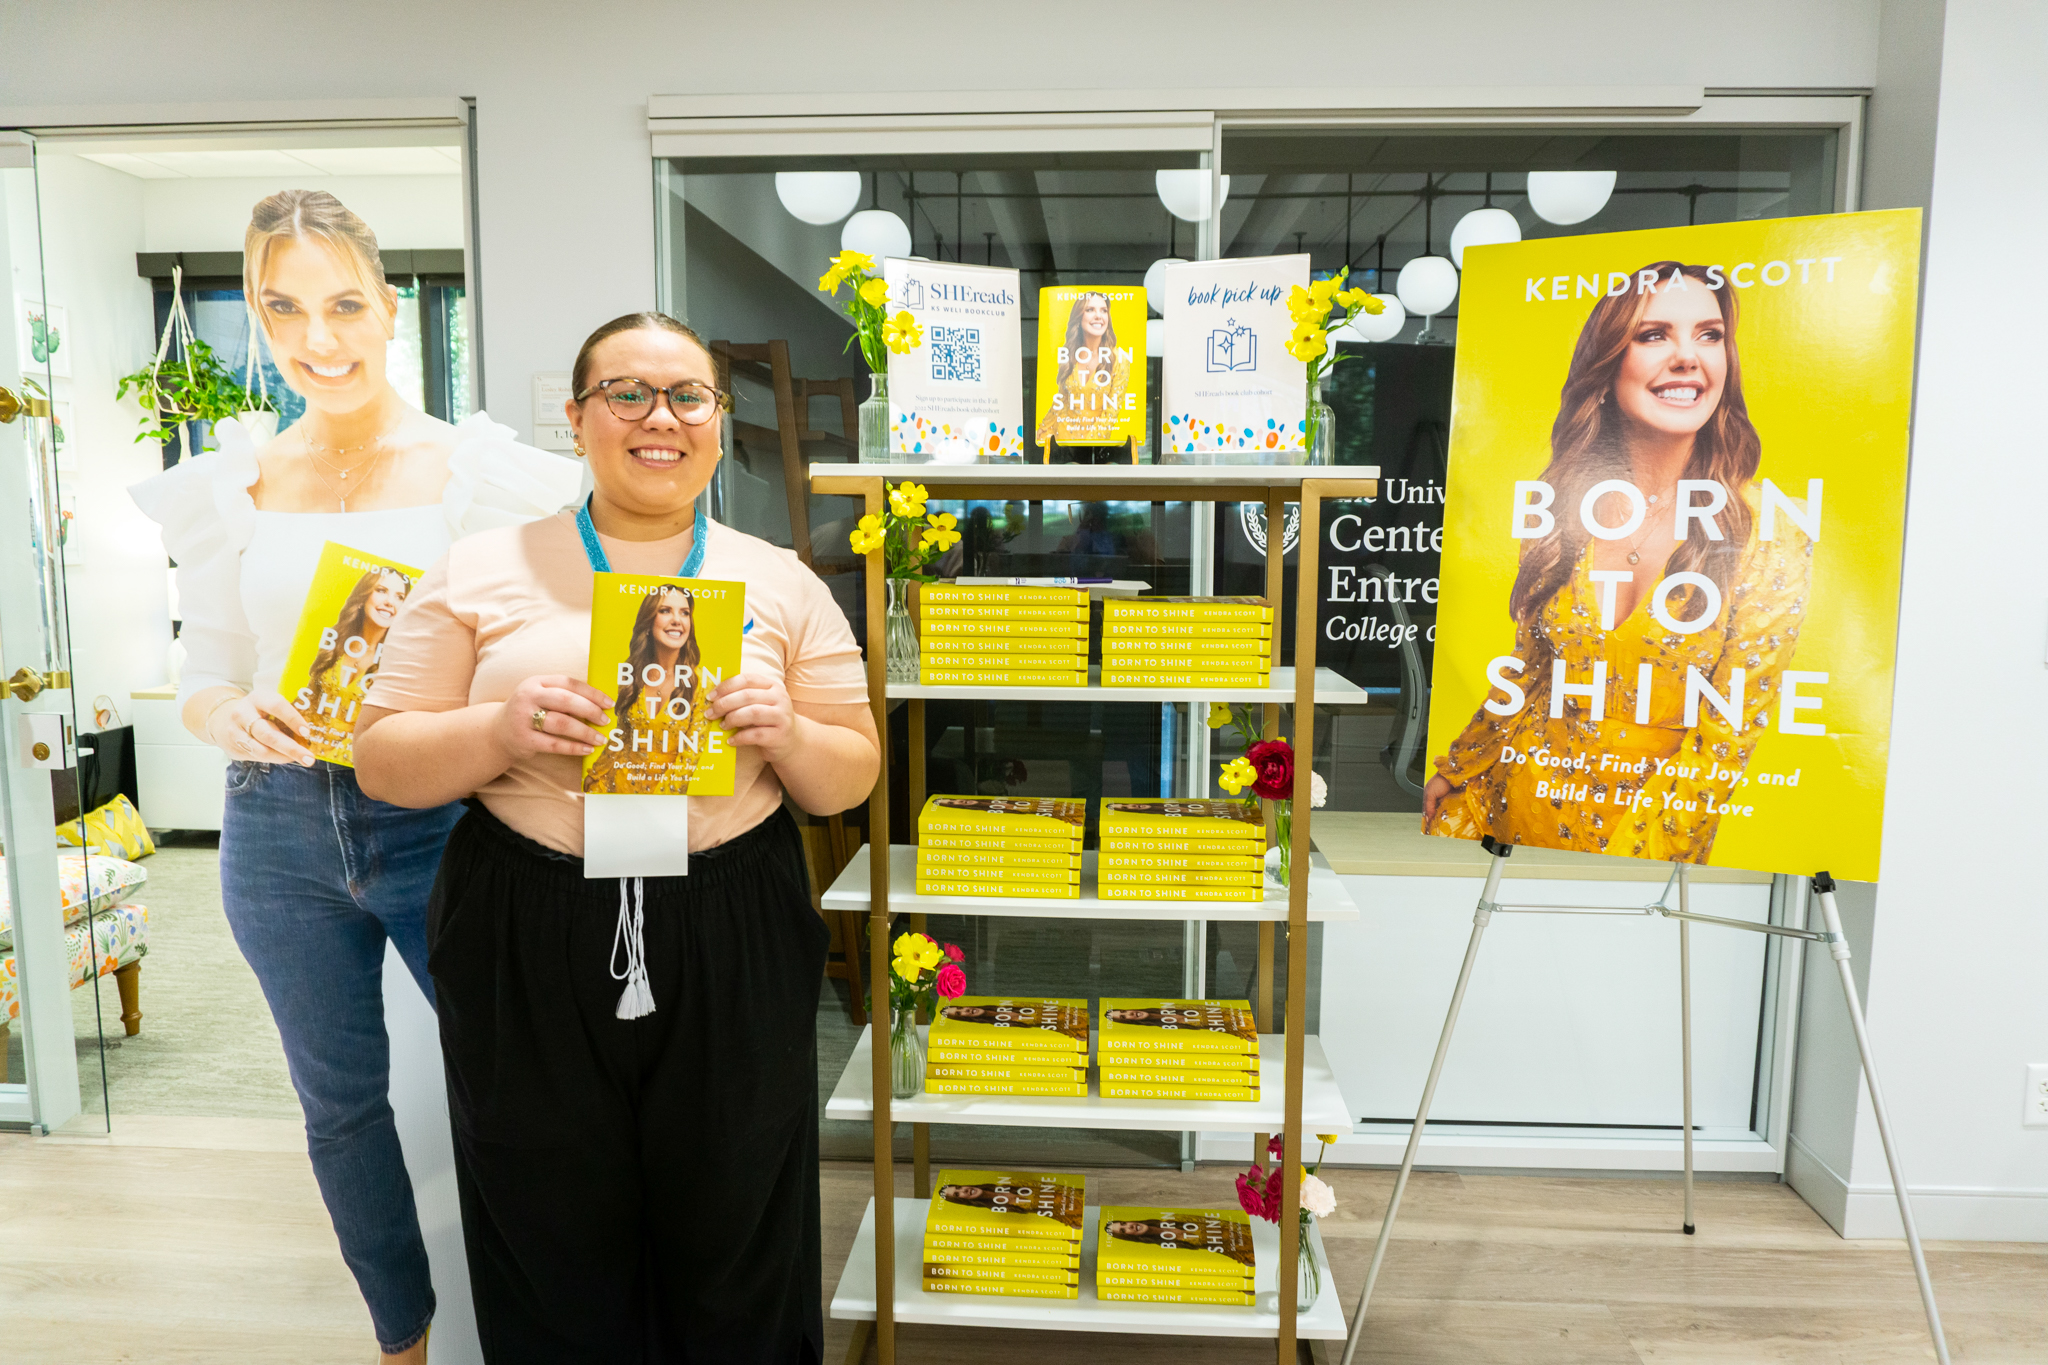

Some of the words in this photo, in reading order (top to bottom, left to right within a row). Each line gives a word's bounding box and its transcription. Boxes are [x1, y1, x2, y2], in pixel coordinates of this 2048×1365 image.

[1525, 267, 1688, 302] KENDRA
[1706, 256, 1842, 291] SCOTT
[930, 283, 1014, 305] SHEreads
[1188, 283, 1220, 306] book
[1222, 281, 1258, 308] pick
[1260, 285, 1284, 306] up
[965, 308, 1005, 316] BOOKCLUB
[1057, 346, 1133, 364] BORN
[1078, 370, 1111, 387] TO
[1052, 393, 1136, 410] SHINE
[1385, 478, 1445, 504] Univ
[1511, 478, 1823, 542] BORN
[1329, 514, 1443, 552] Cente
[342, 556, 398, 576] KENDRA
[619, 584, 678, 597] KENDRA
[683, 588, 727, 599] SCOTT
[1327, 566, 1440, 603] Entre
[929, 592, 958, 601] BORN
[961, 592, 974, 601] TO
[977, 592, 1009, 601] SHINE
[1590, 568, 1722, 634] TO
[929, 607, 958, 616] BORN
[961, 607, 974, 616] TO
[977, 608, 1009, 616] SHINE
[1113, 608, 1143, 617] BORN
[1146, 608, 1159, 617] TO
[1162, 609, 1194, 618] SHINE
[1112, 625, 1142, 634] BORN
[1144, 625, 1158, 634] TO
[1161, 625, 1193, 634] SHINE
[1326, 615, 1418, 649] College
[617, 663, 722, 688] BORN
[294, 687, 356, 722] SHI
[1484, 656, 1829, 736] SHINE
[645, 697, 690, 720] TO
[608, 728, 723, 754] SHINE
[626, 762, 647, 770] Good,
[685, 763, 698, 772] Joy,
[1500, 746, 1526, 764] Do
[1534, 749, 1590, 774] Good,
[1600, 754, 1647, 774] Find
[1654, 758, 1700, 780] Your
[1706, 762, 1750, 788] Joy,
[1758, 768, 1801, 787] and
[655, 774, 668, 783] Life
[1536, 780, 1588, 802] Build
[1594, 791, 1606, 803] a
[1614, 787, 1653, 813] Life
[1662, 791, 1697, 812] You
[1706, 796, 1754, 817] Love
[927, 822, 956, 831] BORN
[959, 823, 972, 832] TO
[975, 824, 1006, 833] SHINE
[1108, 826, 1138, 834] BORN
[1140, 826, 1153, 834] TO
[1156, 826, 1188, 835] SHINE
[994, 1000, 1013, 1027] BORN
[1019, 1007, 1035, 1020] TO
[1041, 1000, 1059, 1030] SHINE
[1160, 1002, 1178, 1030] BORN
[1183, 1010, 1200, 1022] TO
[1205, 1001, 1226, 1032] SHINE
[937, 1038, 965, 1046] BORN
[983, 1039, 1012, 1048] SHINE
[1107, 1040, 1136, 1049] BORN
[1138, 1041, 1150, 1049] TO
[1153, 1041, 1183, 1050] SHINE
[991, 1176, 1012, 1213] BORN
[1016, 1187, 1033, 1204] TO
[1037, 1176, 1056, 1217] SHINE
[934, 1223, 962, 1232] BORN
[965, 1225, 976, 1233] TO
[980, 1226, 1009, 1235] SHINE
[1160, 1212, 1177, 1249] BORN
[1183, 1223, 1199, 1239] TO
[1204, 1212, 1224, 1253] SHINE
[1106, 1262, 1134, 1270] BORN
[1136, 1263, 1148, 1271] TO
[1151, 1264, 1181, 1272] SHINE
